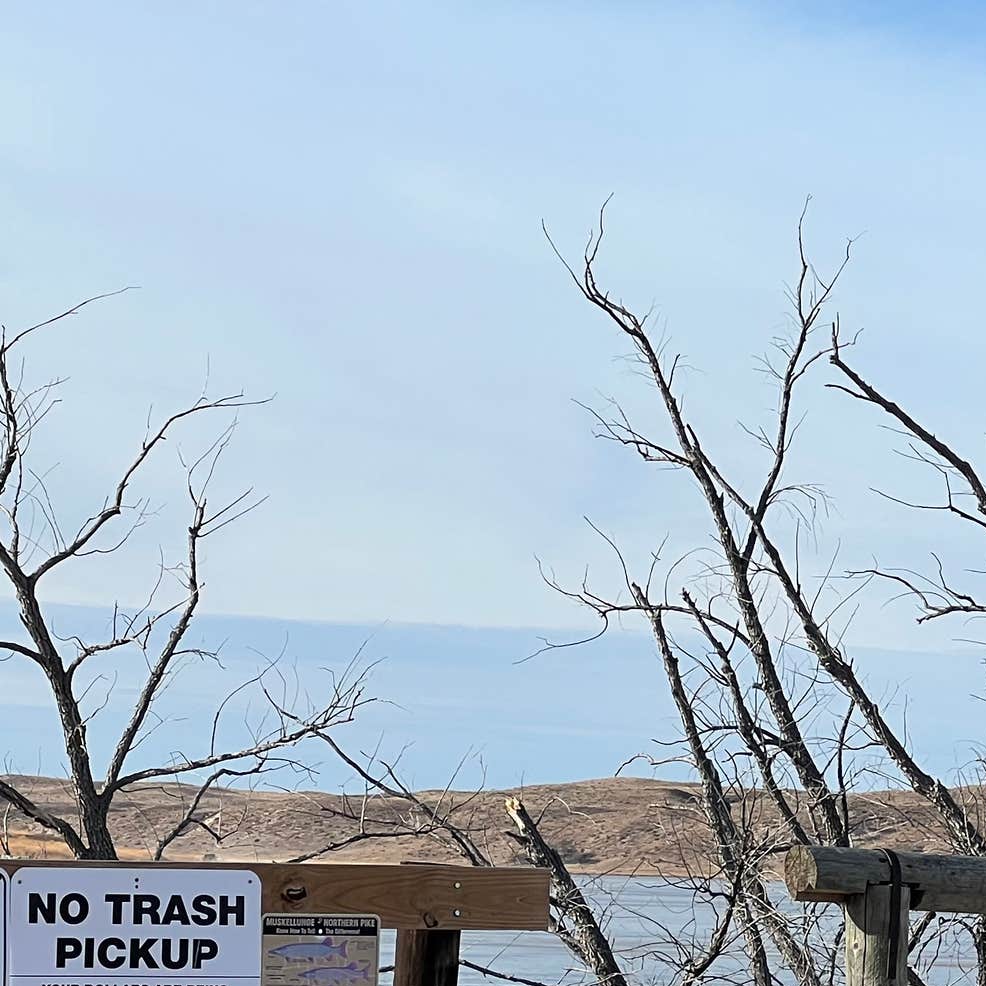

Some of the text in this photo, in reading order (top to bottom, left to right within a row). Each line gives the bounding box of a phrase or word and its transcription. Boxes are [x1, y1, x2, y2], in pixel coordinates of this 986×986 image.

[28, 892, 245, 926] NO TRASH
[360, 919, 375, 927] PIKE
[56, 937, 218, 969] PICKUP
